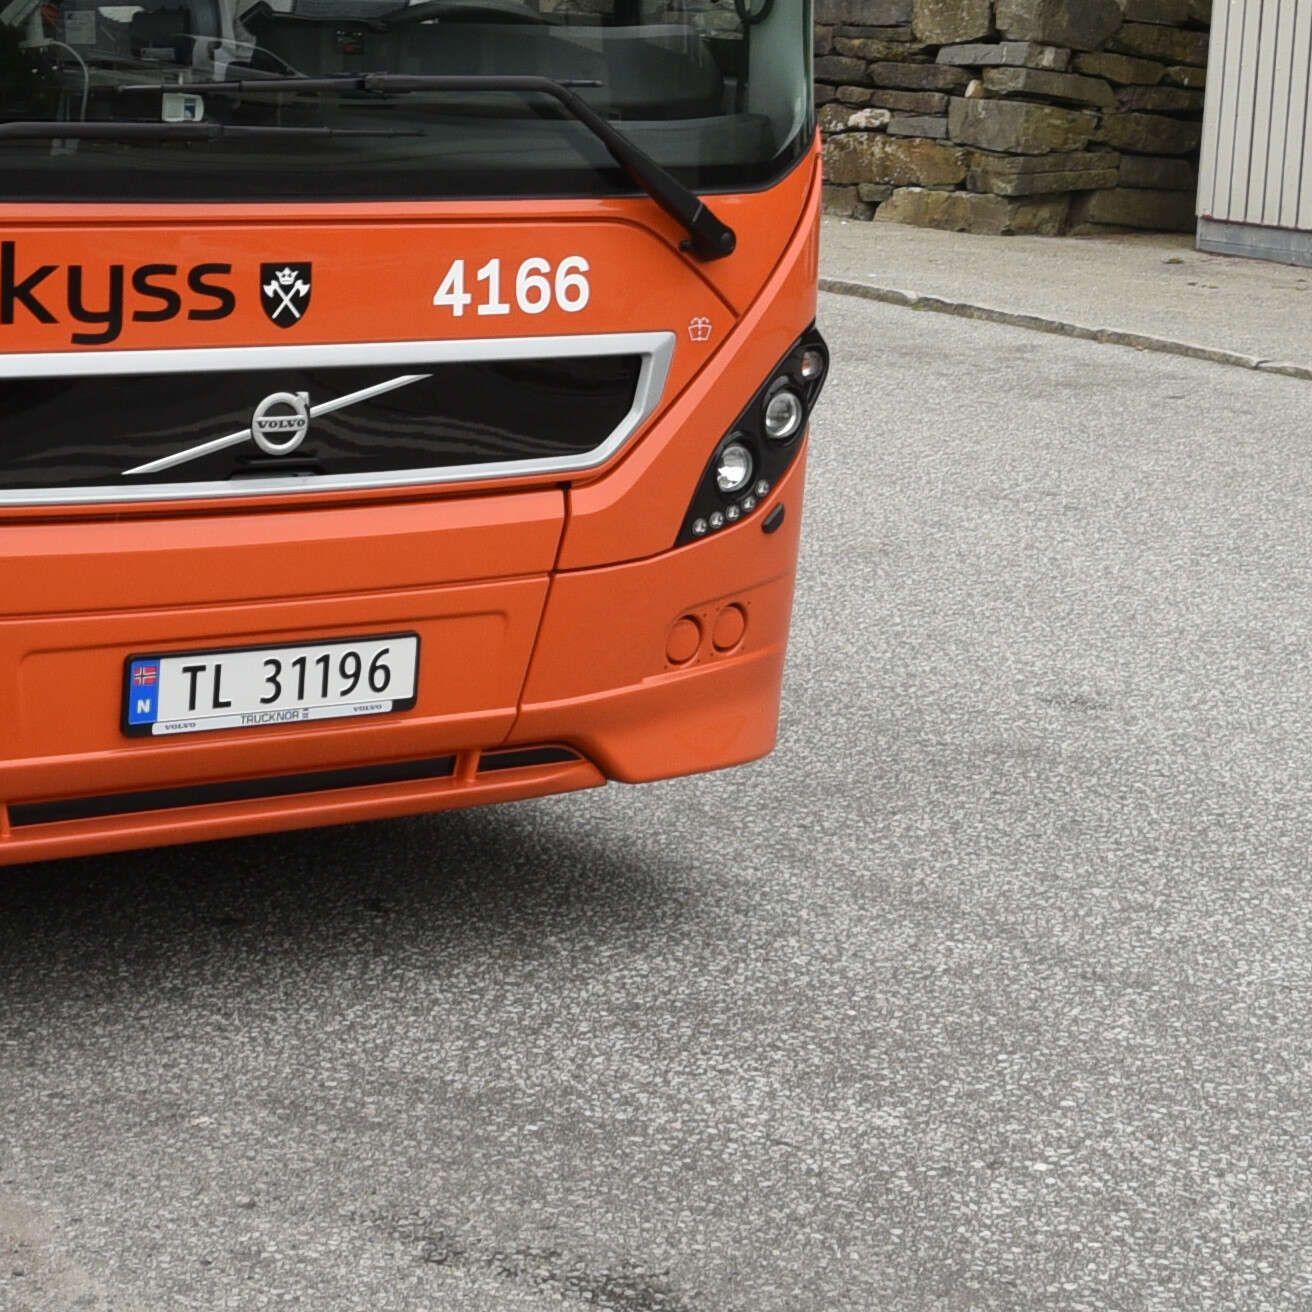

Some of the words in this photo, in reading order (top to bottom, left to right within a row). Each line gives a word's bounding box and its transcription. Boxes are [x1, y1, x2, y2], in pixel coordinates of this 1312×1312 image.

[433, 256, 590, 316] 4166
[257, 419, 306, 429] VOLVO
[182, 664, 231, 711] TL
[260, 648, 390, 704] 31196
[137, 698, 151, 714] N
[164, 722, 196, 731] VOLVO
